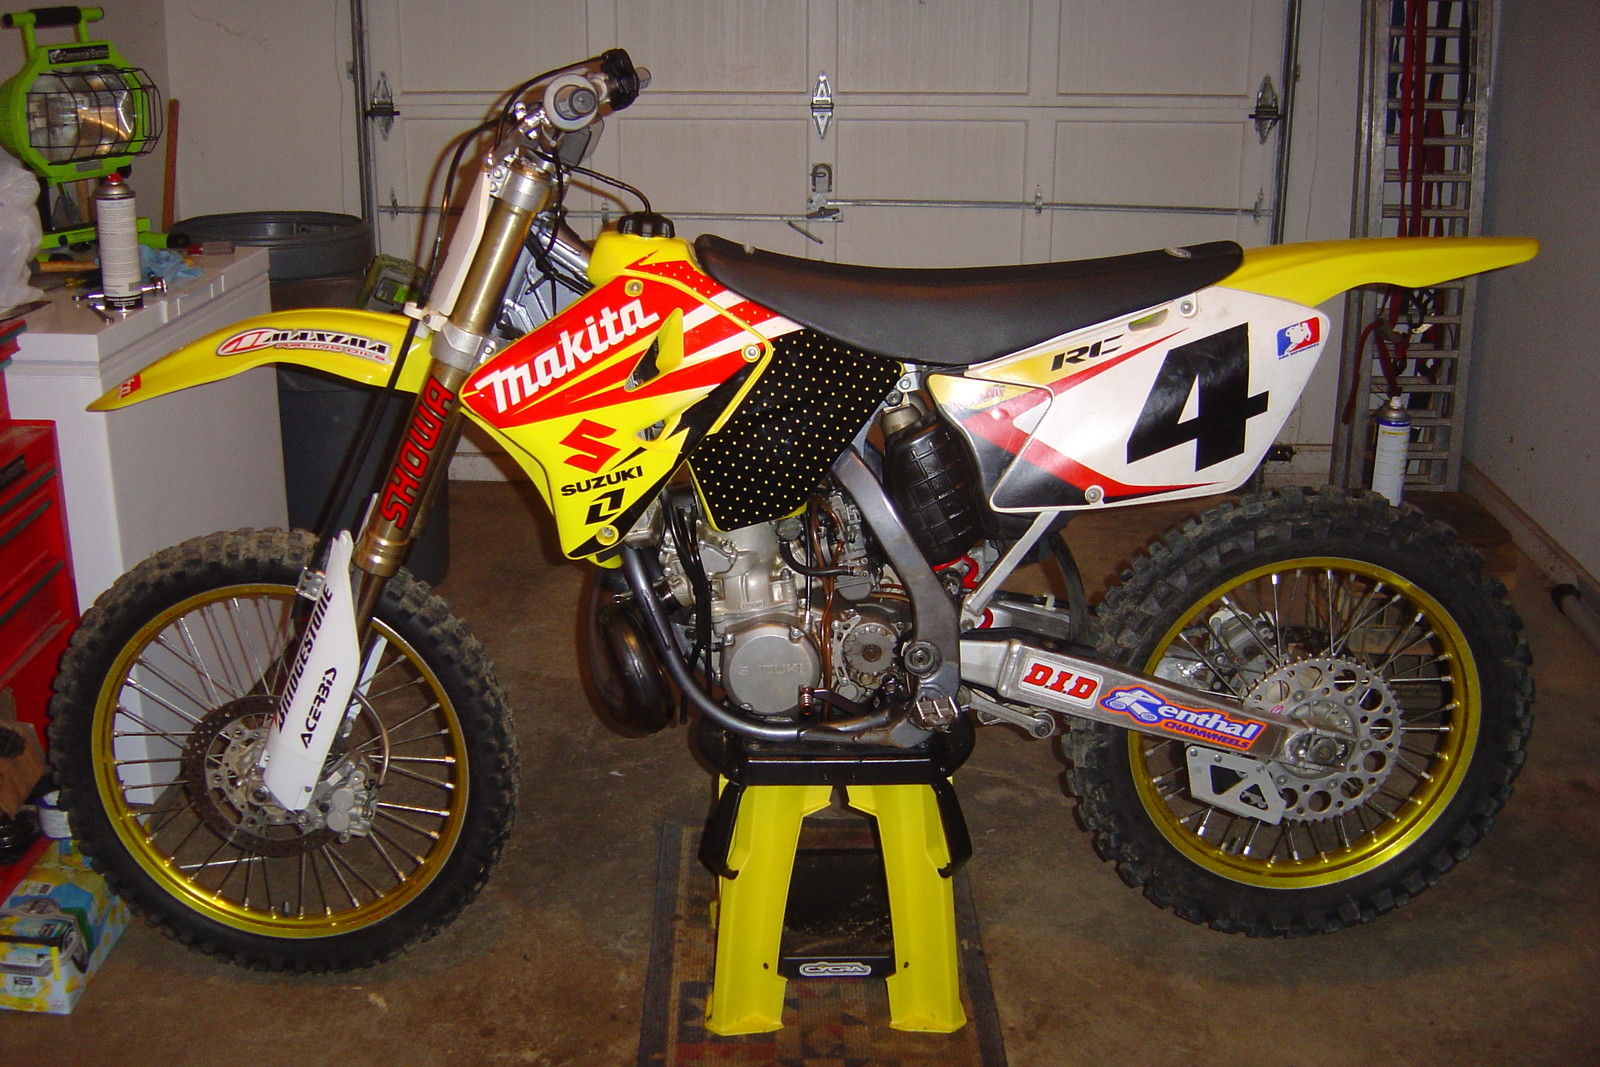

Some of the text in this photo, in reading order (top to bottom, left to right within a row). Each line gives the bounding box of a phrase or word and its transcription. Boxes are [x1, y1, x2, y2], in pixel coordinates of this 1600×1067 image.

[275, 343, 342, 351] RACING
[1051, 333, 1125, 372] RC
[1126, 321, 1270, 472] 4
[380, 375, 455, 530] SHOWA
[561, 465, 643, 497] SUZUKI
[277, 583, 333, 734] BRIDGESTONE
[300, 666, 337, 748] ACERBIS
[1164, 721, 1250, 749] CHAINWHEELS
